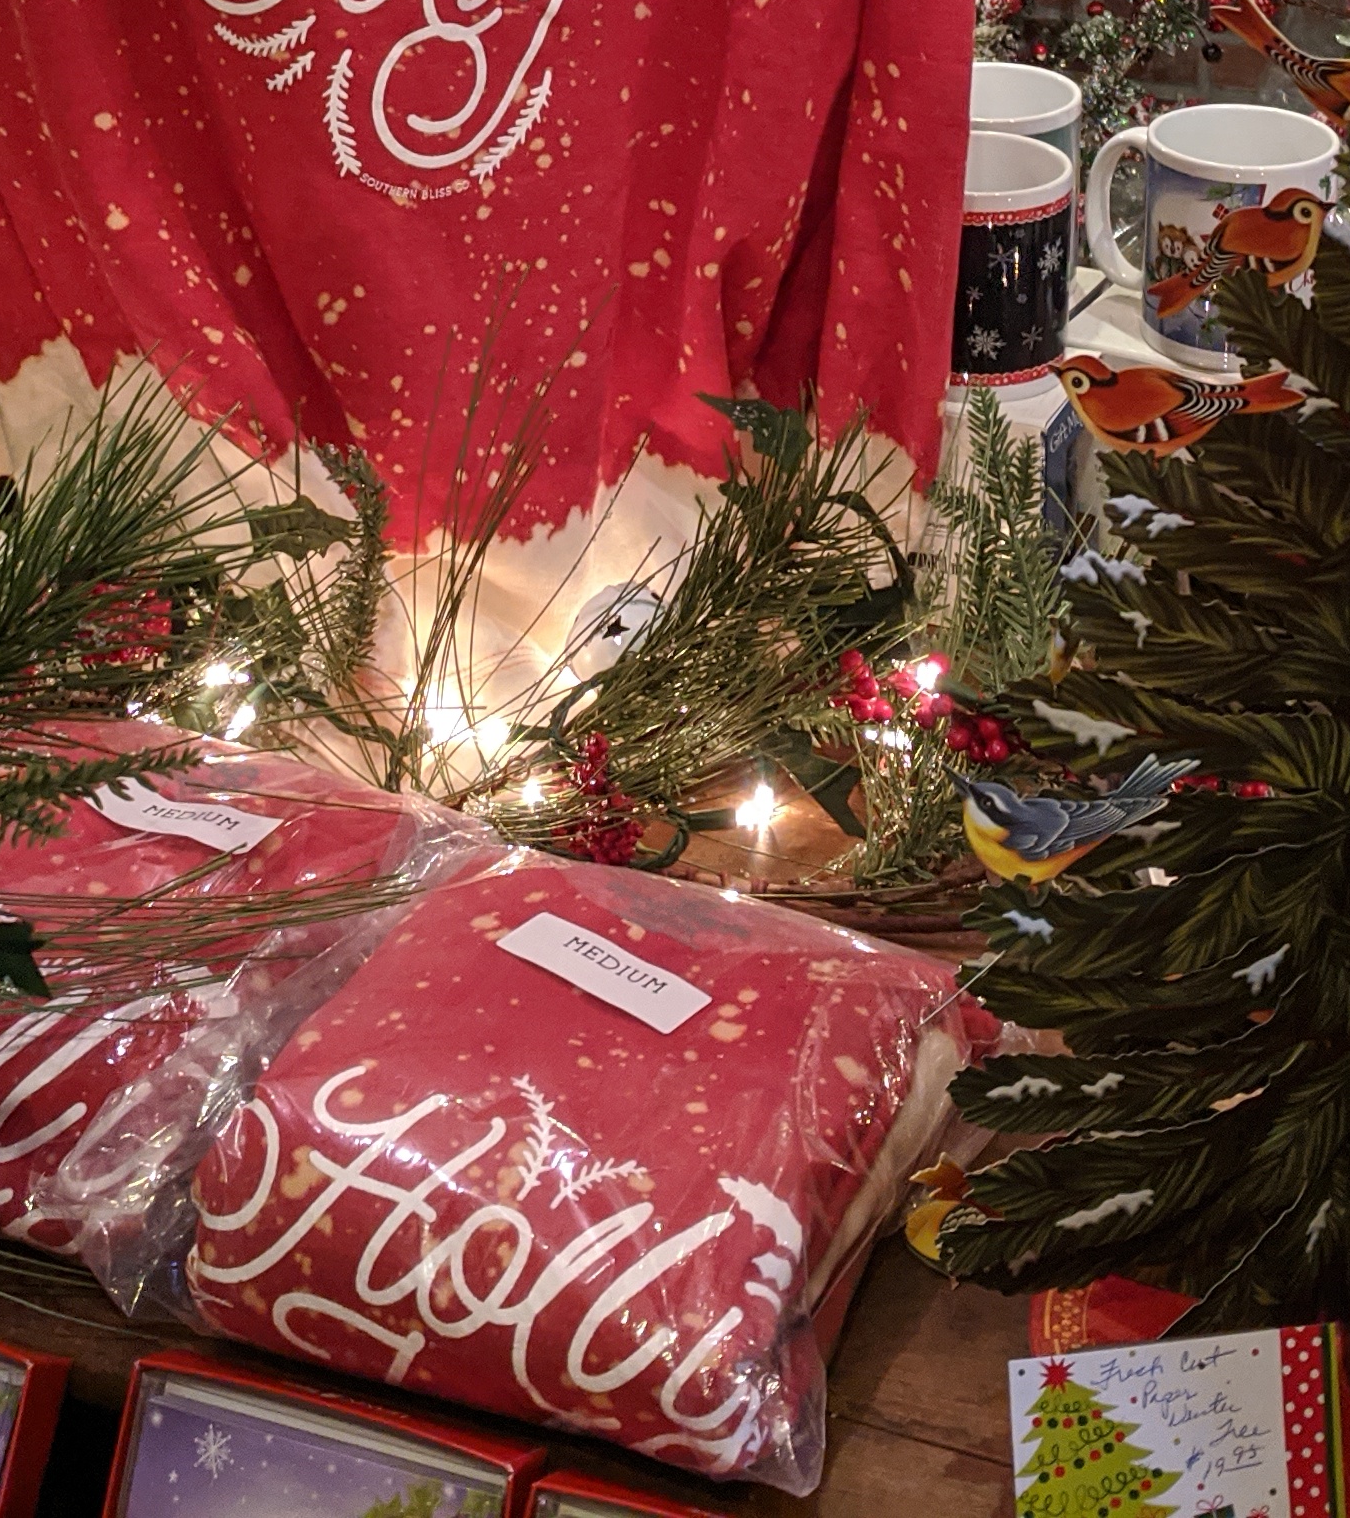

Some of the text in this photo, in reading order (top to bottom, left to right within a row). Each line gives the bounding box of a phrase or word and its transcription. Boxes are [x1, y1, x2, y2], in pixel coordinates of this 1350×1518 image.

[359, 172, 418, 200] SOUTHERN
[420, 186, 453, 201] BLISS
[142, 804, 241, 831] MEDIUM
[562, 935, 669, 995] MEDIUM
[189, 1065, 782, 1474] Holly
[1209, 1418, 1274, 1446] Tree
